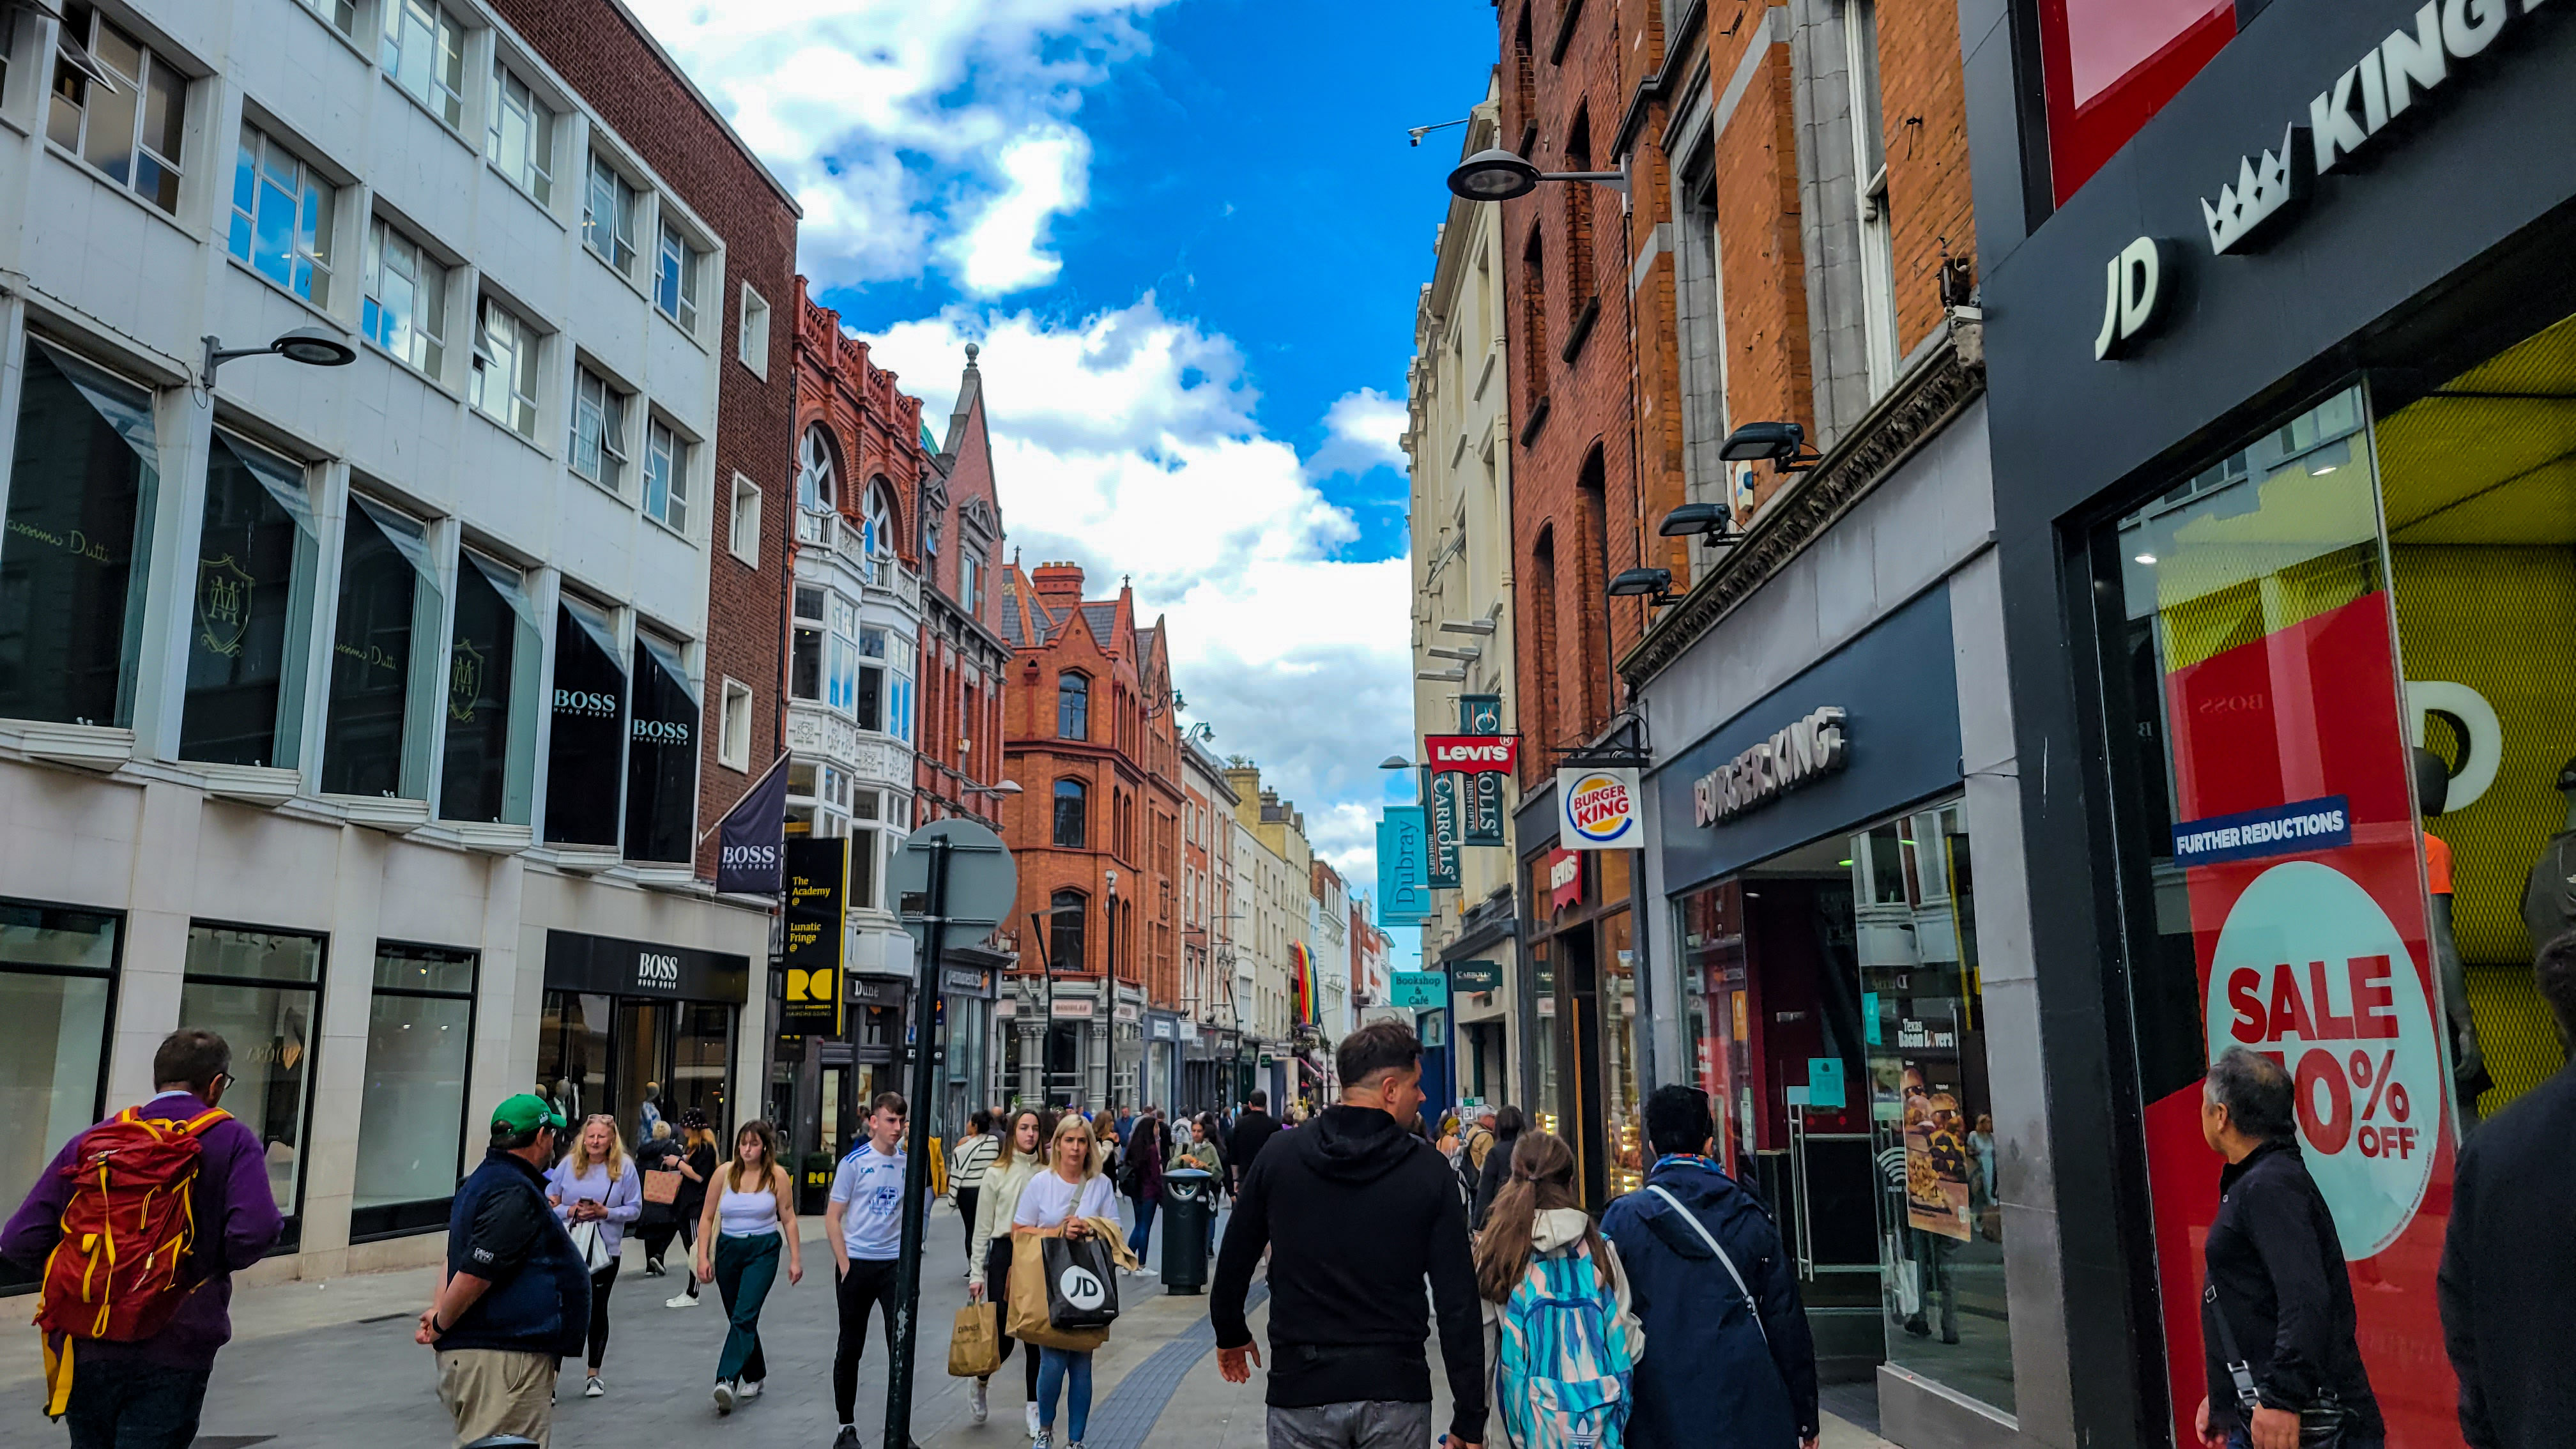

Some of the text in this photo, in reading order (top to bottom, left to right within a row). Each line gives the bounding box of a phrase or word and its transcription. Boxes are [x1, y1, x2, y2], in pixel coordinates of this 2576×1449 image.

[2095, 236, 2159, 362] JD
[6, 519, 111, 563] assimo Dutti
[371, 645, 397, 670] Dutti
[555, 689, 616, 712] BOSS
[633, 719, 689, 740] BOSS
[1475, 712, 1498, 830] COLLS
[1694, 706, 1846, 828] BURGER KING
[1574, 785, 1626, 811] BURGER
[1467, 805, 1475, 830] GIFTS
[1577, 797, 1629, 828] KING
[1433, 777, 1455, 876] CARROLLS
[2176, 809, 2344, 855] FURTHER REDUCTIONS
[723, 845, 776, 864] BOSS
[1395, 820, 1420, 905] Dubray
[792, 876, 809, 885] The
[792, 886, 831, 898] Academy
[792, 898, 800, 906] @
[790, 923, 822, 931] Lunatic
[790, 933, 816, 945] Fringe
[790, 944, 798, 952] @
[638, 952, 678, 981] BOSS
[854, 980, 880, 997] Dune
[1396, 976, 1441, 986] Bookshop
[1414, 986, 1422, 995] &
[1408, 995, 1429, 1005] Café
[2227, 954, 2400, 1045] SALE
[1903, 1018, 1922, 1032] Texas
[1897, 1031, 1924, 1048] Bacon
[2358, 1125, 2416, 1160] OFF
[1070, 1275, 1098, 1298] JD
